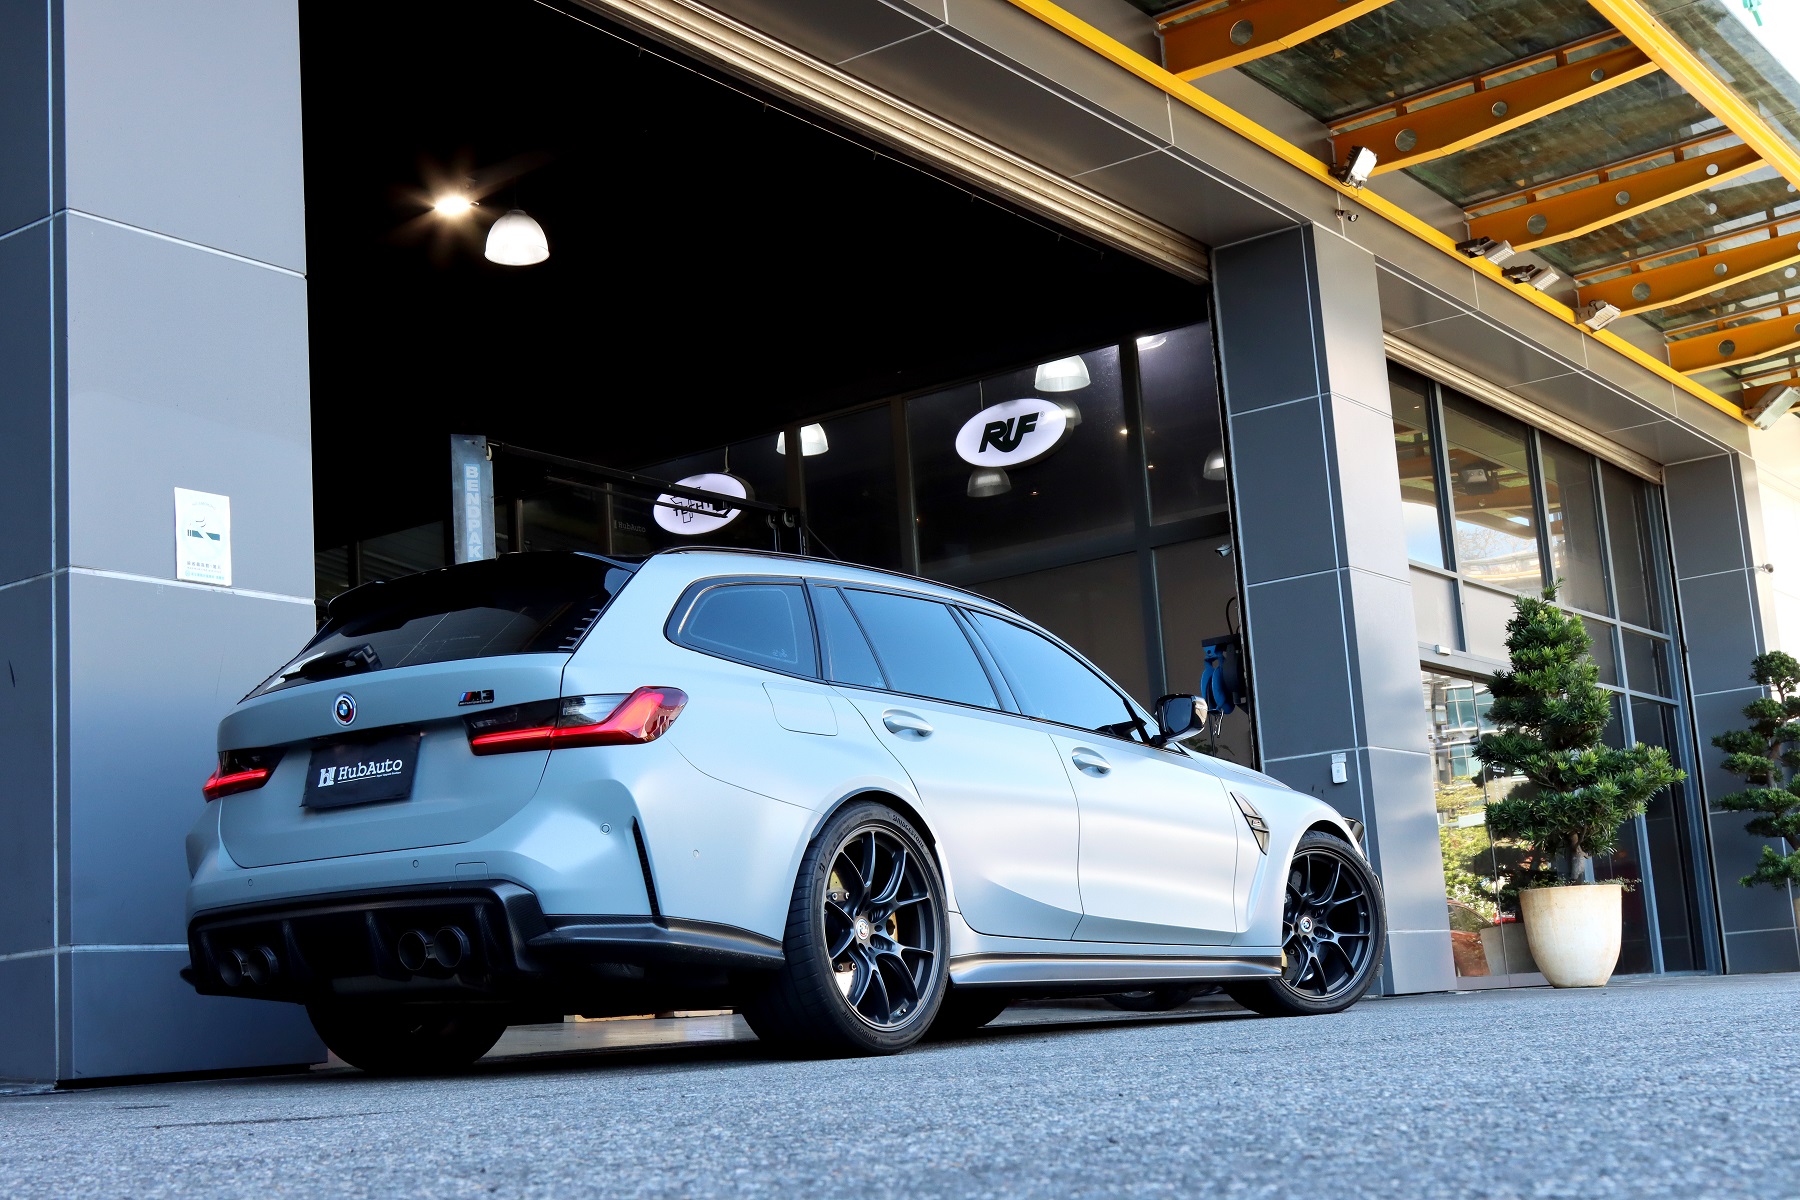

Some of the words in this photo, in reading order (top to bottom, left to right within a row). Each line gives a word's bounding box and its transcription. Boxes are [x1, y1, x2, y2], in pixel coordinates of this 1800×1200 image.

[978, 412, 1039, 453] RUF
[465, 465, 482, 558] BENDPAK
[338, 759, 402, 780] HubAuto
